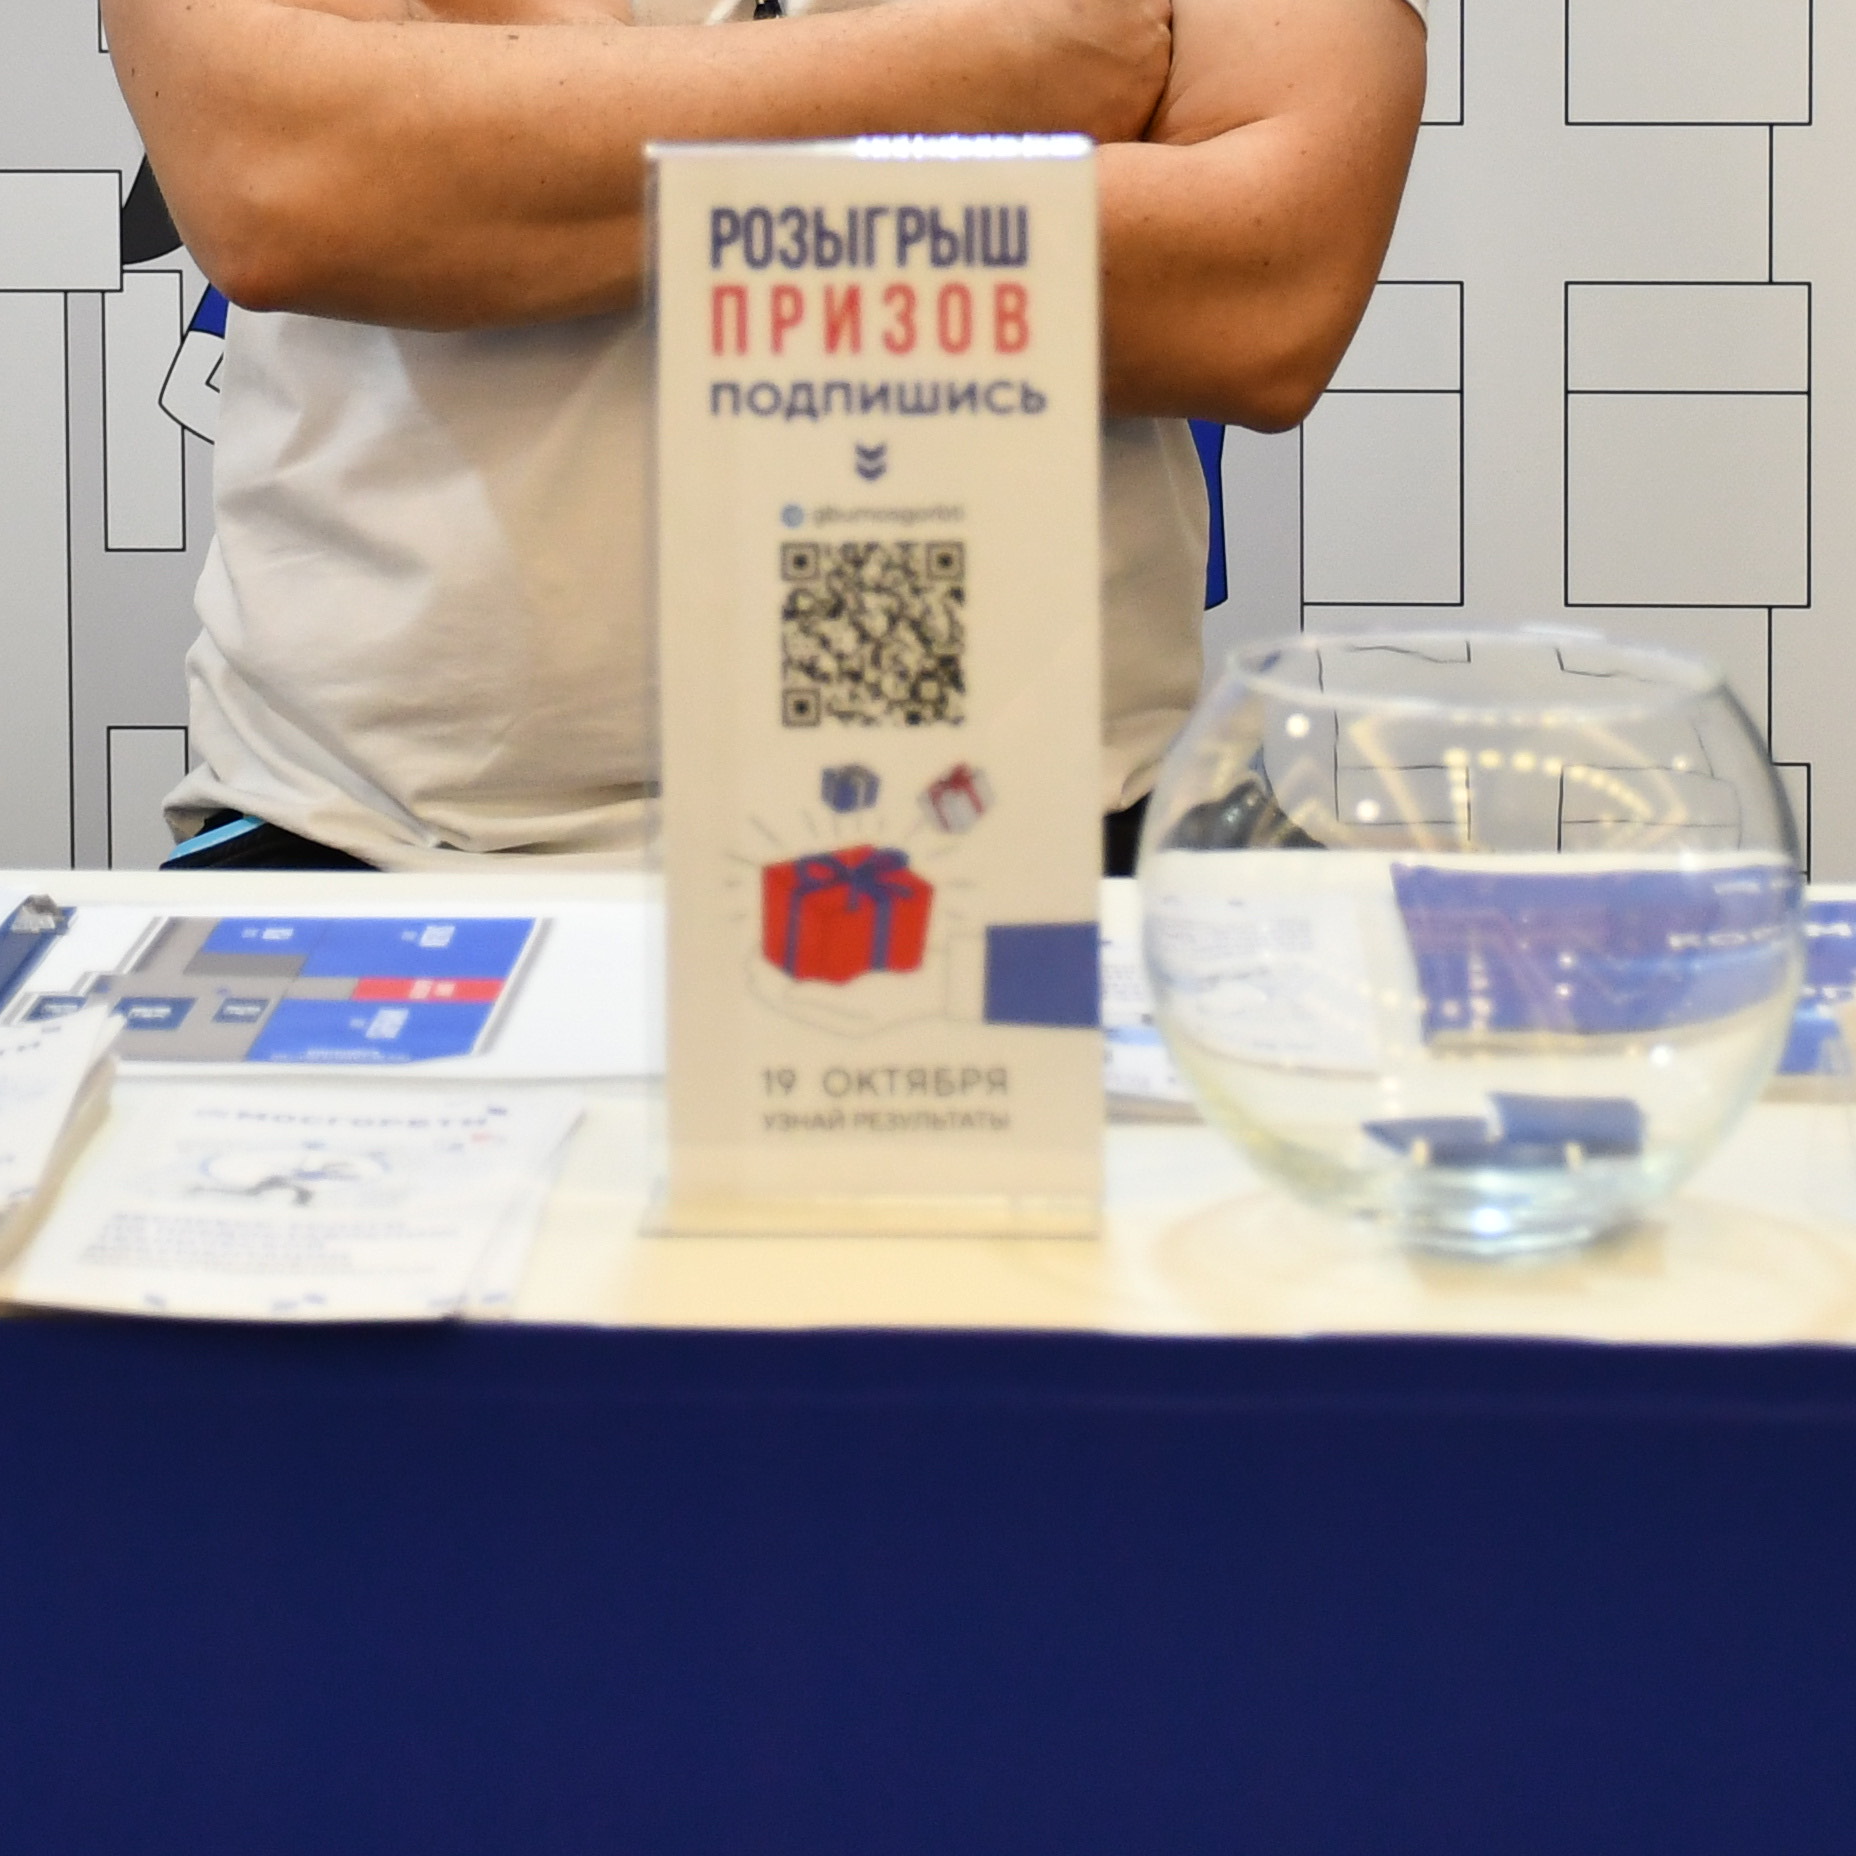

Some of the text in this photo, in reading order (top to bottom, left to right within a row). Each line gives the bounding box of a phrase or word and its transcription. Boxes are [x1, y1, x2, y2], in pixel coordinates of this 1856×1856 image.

[710, 205, 1030, 271] РОЗЫГРЫШ
[710, 281, 1030, 357] ПРИЗОВ
[762, 1066, 1009, 1098] 19 ОКТЯБРЯ
